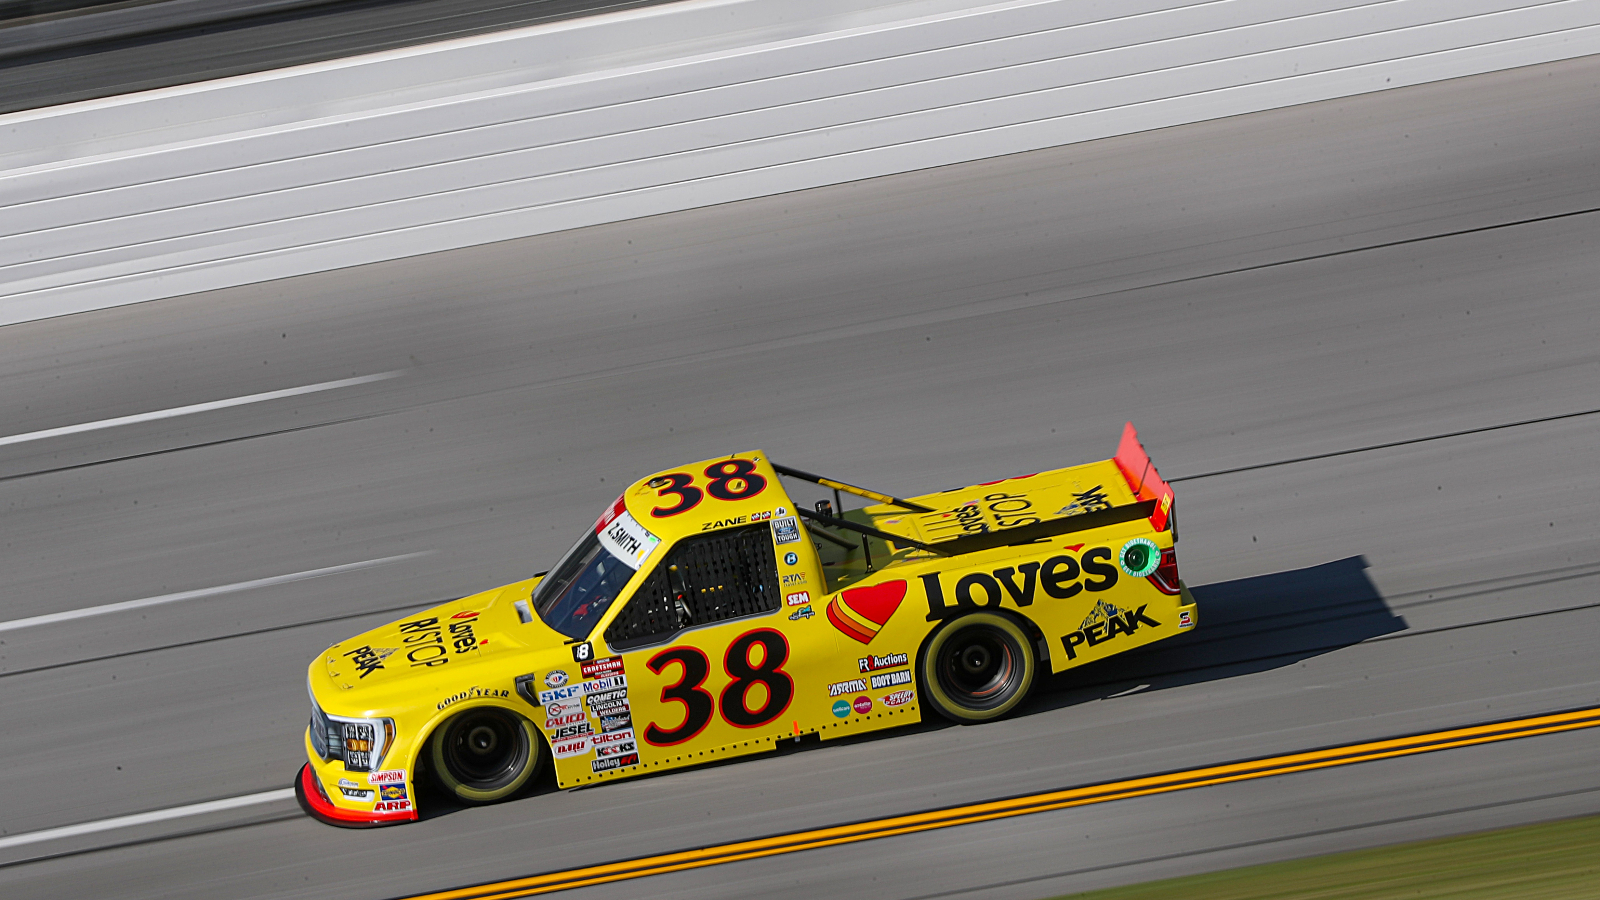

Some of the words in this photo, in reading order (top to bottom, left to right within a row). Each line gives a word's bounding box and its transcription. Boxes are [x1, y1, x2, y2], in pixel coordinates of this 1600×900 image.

[643, 459, 768, 518] 38
[1072, 484, 1113, 514] EAK
[983, 492, 1041, 527] STOP
[701, 515, 748, 531] ZANE
[774, 518, 795, 529] BUILT
[776, 533, 798, 542] TOUGH
[782, 573, 802, 584] RTA
[787, 591, 810, 606] SEM
[1060, 603, 1162, 661] PEAK
[402, 631, 449, 667] STOP
[342, 645, 386, 680] PEAK
[583, 660, 622, 674] CRAFTSMAN
[582, 678, 613, 693] Mobil
[643, 627, 795, 747] 38
[871, 674, 891, 690] BOOT
[891, 670, 912, 685] BARN
[541, 685, 580, 703] SKF
[586, 689, 627, 704] COMETIC
[591, 699, 623, 712] LINCOLN
[599, 705, 627, 717] WELDERS
[545, 712, 586, 729] CALICO
[550, 723, 595, 740] JESEL
[591, 731, 632, 745] tilton
[592, 757, 621, 771] Holley
[370, 770, 404, 783] SIMPSON
[373, 800, 412, 812] ARP
